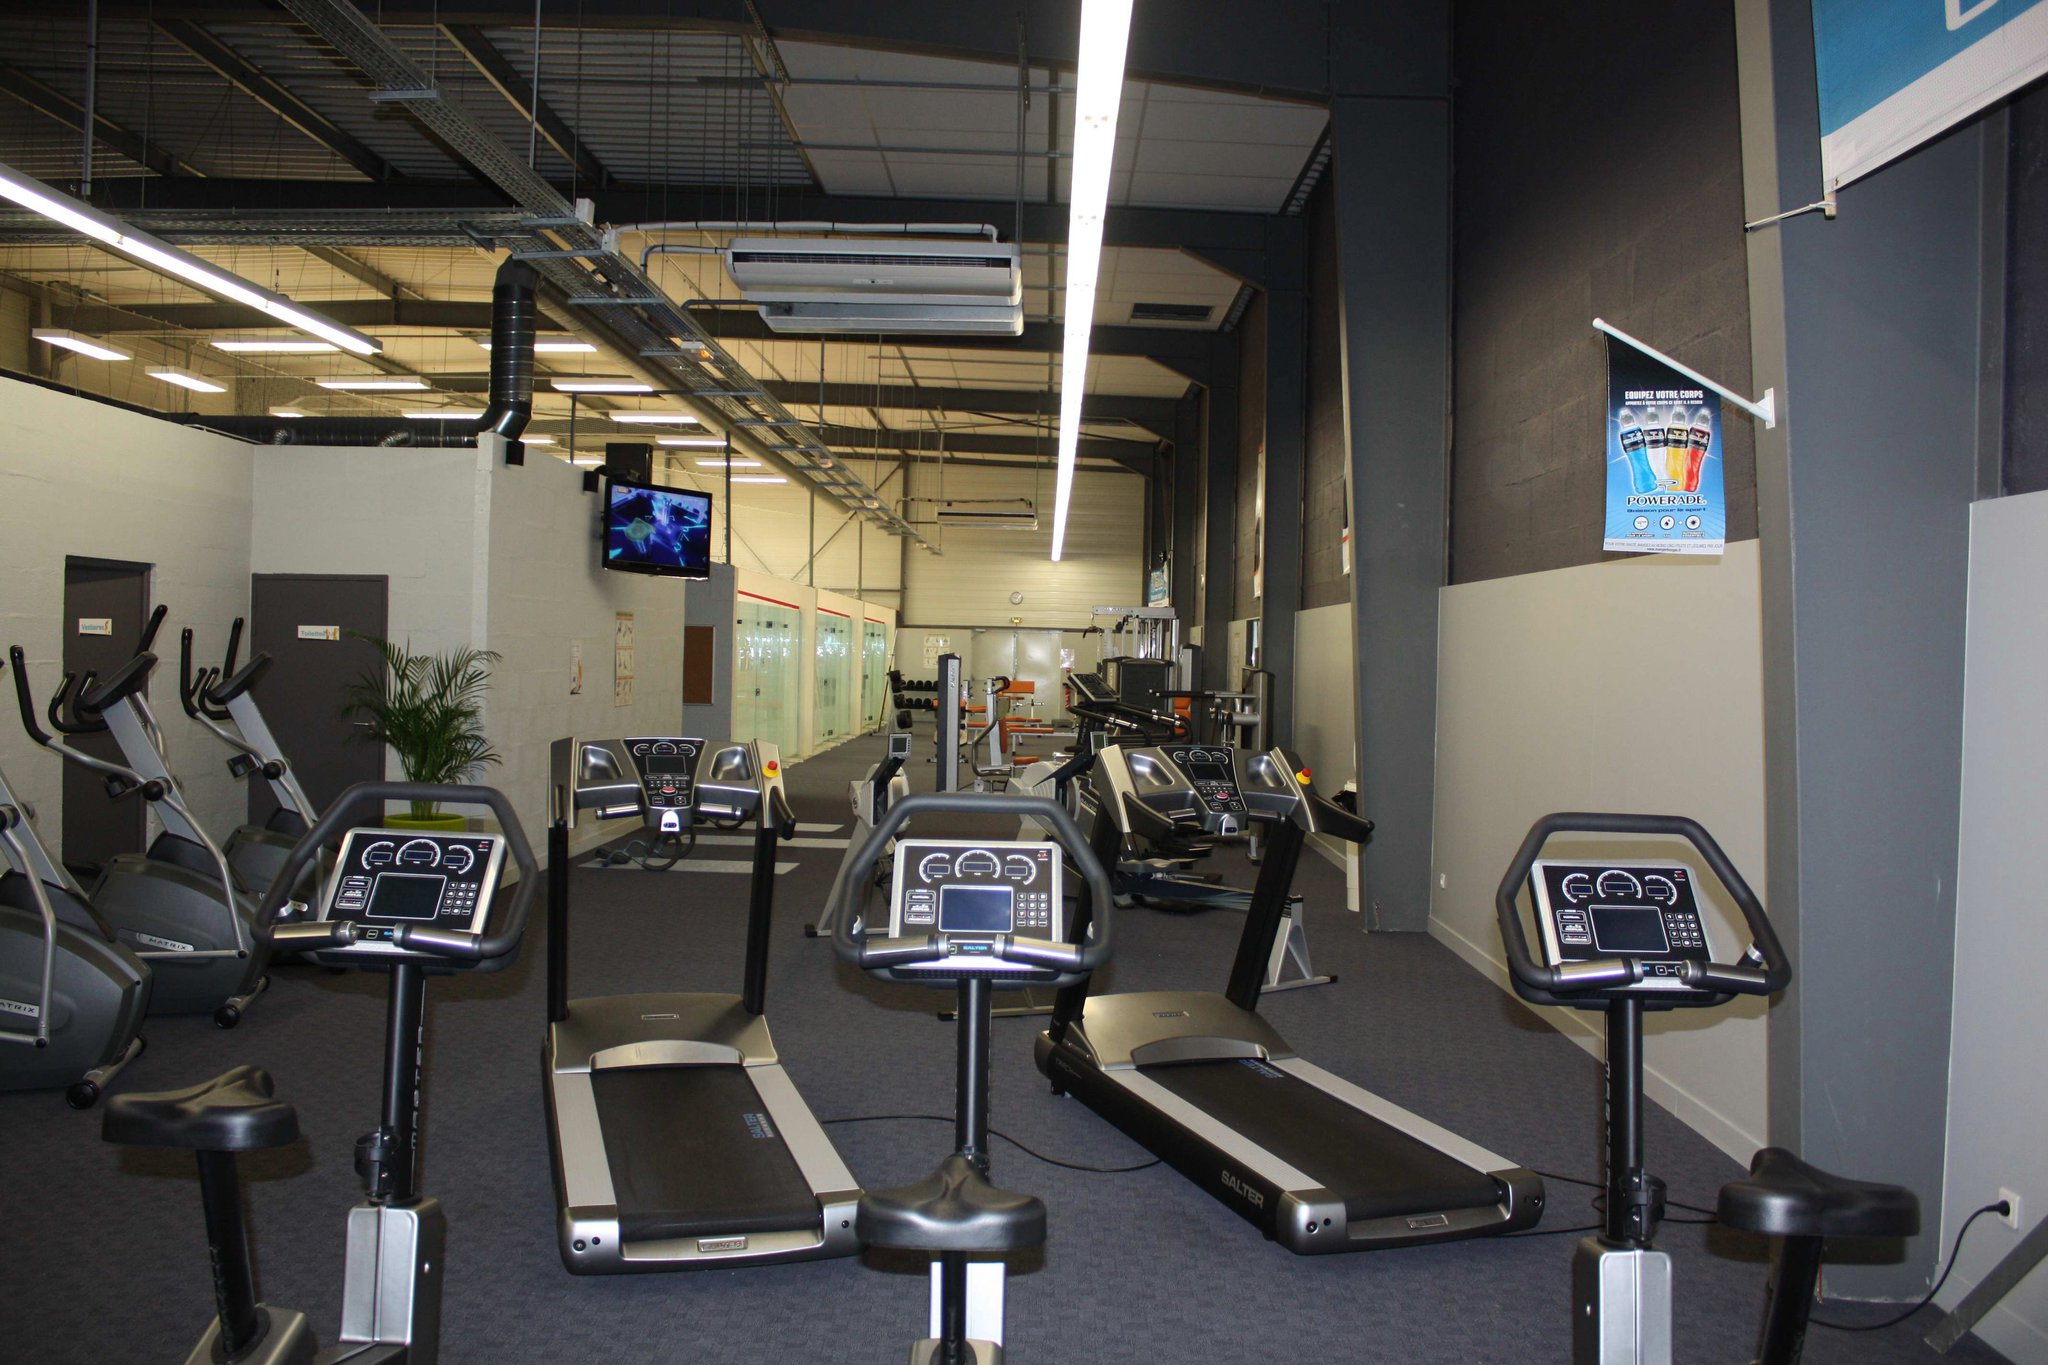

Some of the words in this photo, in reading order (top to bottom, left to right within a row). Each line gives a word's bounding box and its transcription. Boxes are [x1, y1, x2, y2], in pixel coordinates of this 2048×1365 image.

[1624, 390, 1654, 400] EQUIPEZ
[1655, 390, 1679, 399] VOTRE
[1680, 389, 1704, 399] CORPS
[148, 937, 186, 950] MATRIX
[0, 1001, 35, 1014] ATRIX
[1220, 1169, 1264, 1209] SALTER
